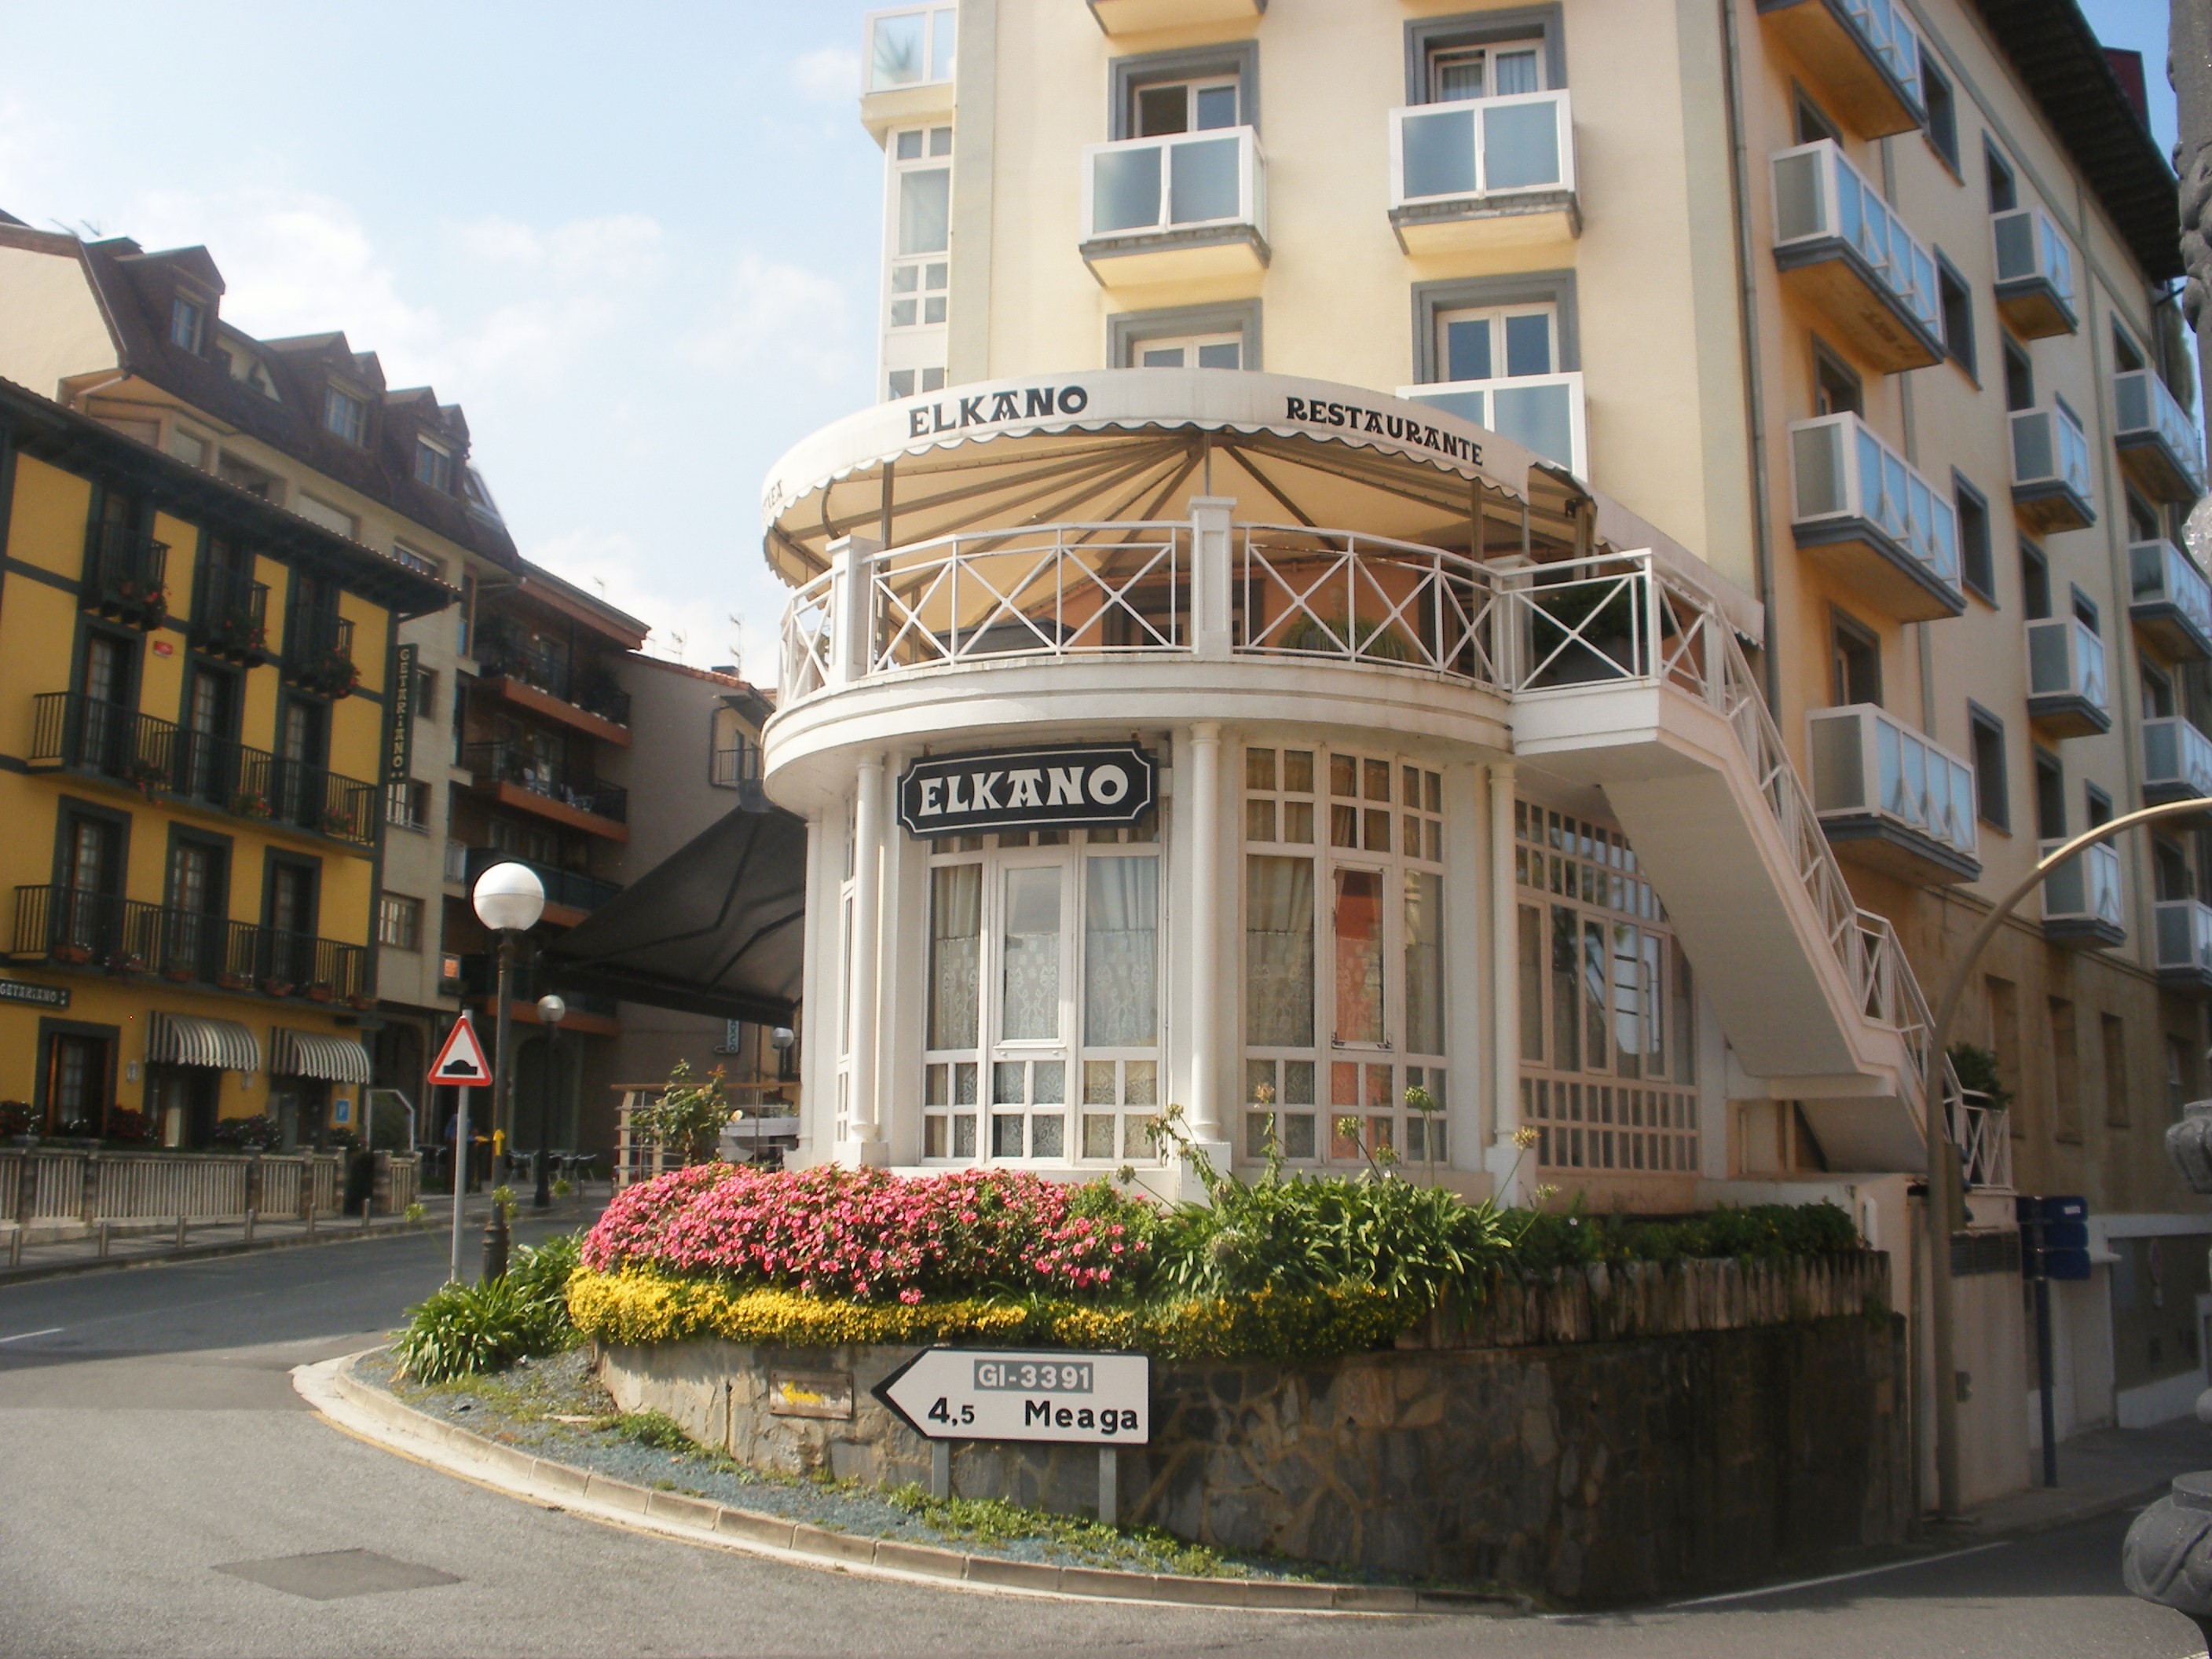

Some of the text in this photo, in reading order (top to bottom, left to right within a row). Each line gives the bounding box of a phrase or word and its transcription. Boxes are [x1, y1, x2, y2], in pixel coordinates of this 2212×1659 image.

[908, 385, 1088, 438] ELKANO
[1286, 396, 1484, 467] RESTAURANTE
[917, 764, 1129, 817] ELKANO
[978, 1364, 1090, 1390] GI-3391
[928, 1397, 1139, 1435] 4,5 Meaga
